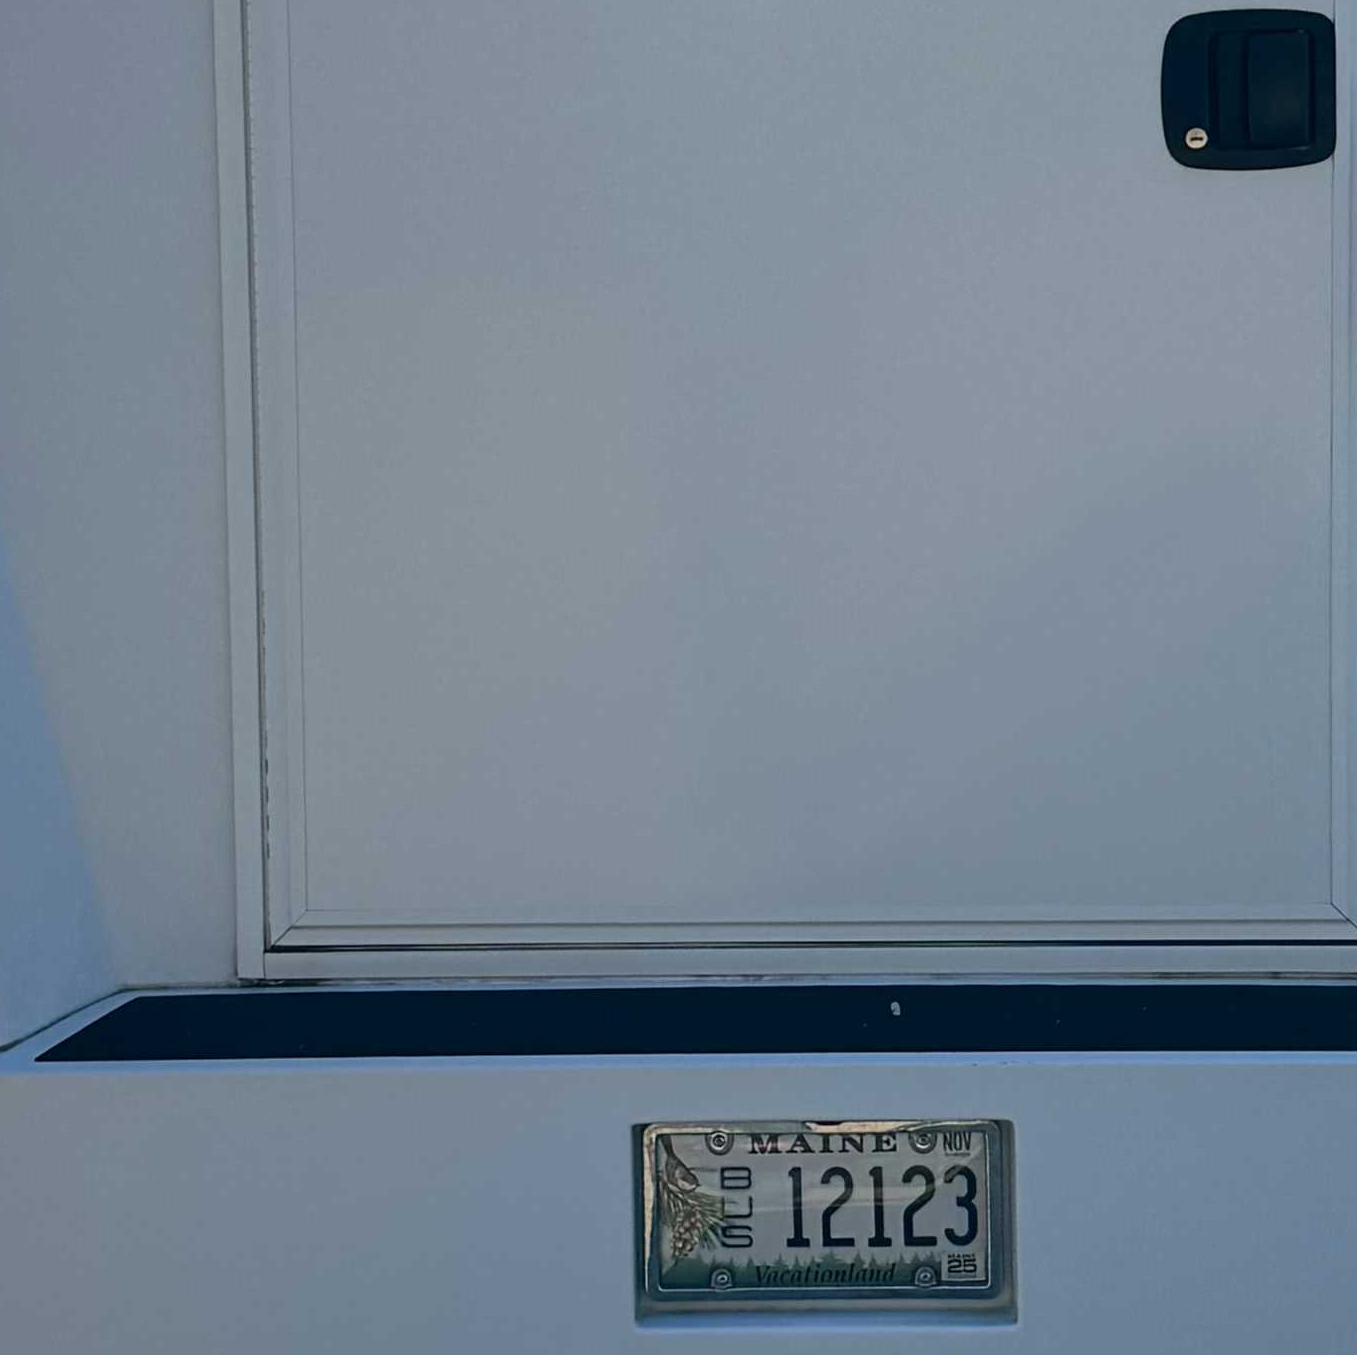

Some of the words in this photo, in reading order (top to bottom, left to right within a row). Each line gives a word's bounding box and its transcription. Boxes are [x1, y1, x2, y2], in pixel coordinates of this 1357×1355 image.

[748, 1132, 898, 1155] MAINE
[943, 1131, 972, 1152] NOV
[720, 1166, 754, 1248] BUS
[786, 1164, 979, 1248] 12123
[754, 1263, 897, 1286] Vacationland
[947, 1258, 978, 1274] 25
